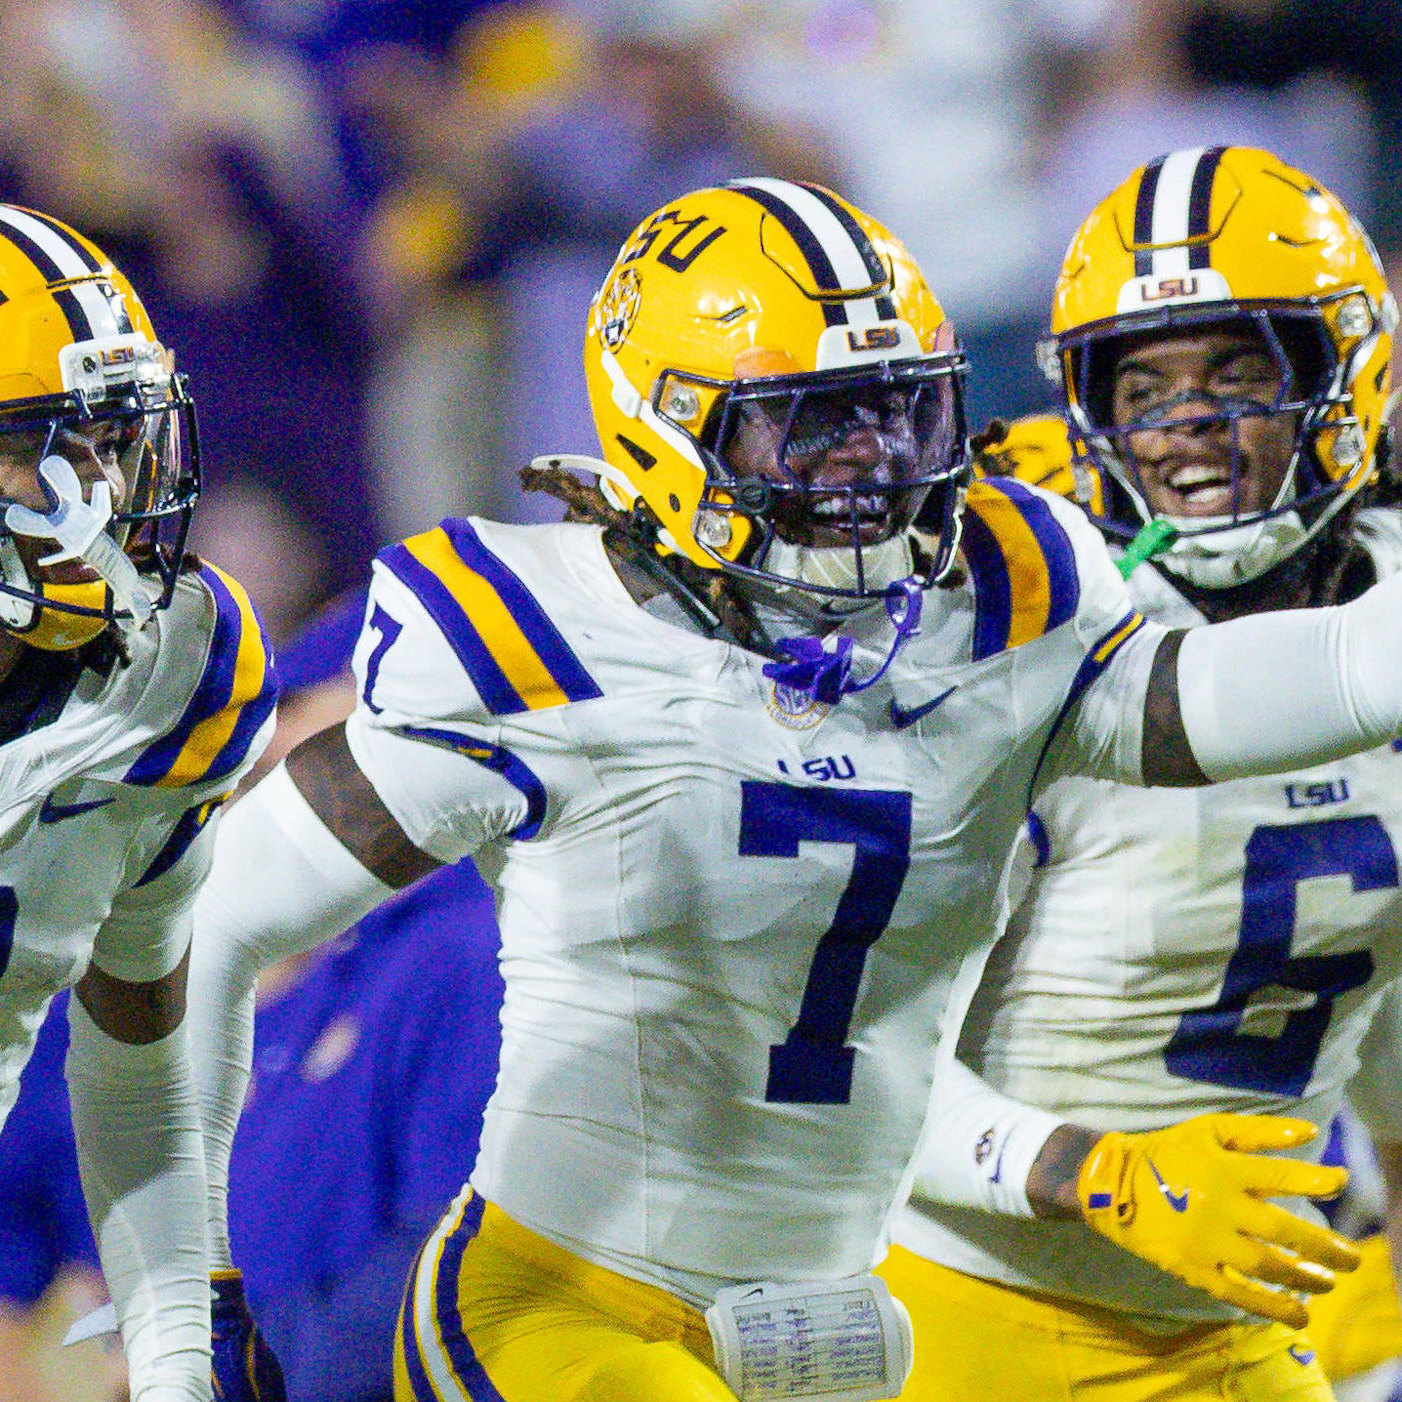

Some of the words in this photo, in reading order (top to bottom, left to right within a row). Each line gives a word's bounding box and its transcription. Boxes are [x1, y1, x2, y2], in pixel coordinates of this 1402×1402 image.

[623, 210, 727, 274] SU
[1141, 277, 1198, 302] LSU
[846, 327, 901, 352] LSU
[362, 601, 404, 715] 7
[1285, 779, 1349, 808] LSU
[738, 779, 913, 1105] 7
[1163, 814, 1400, 1097] 6
